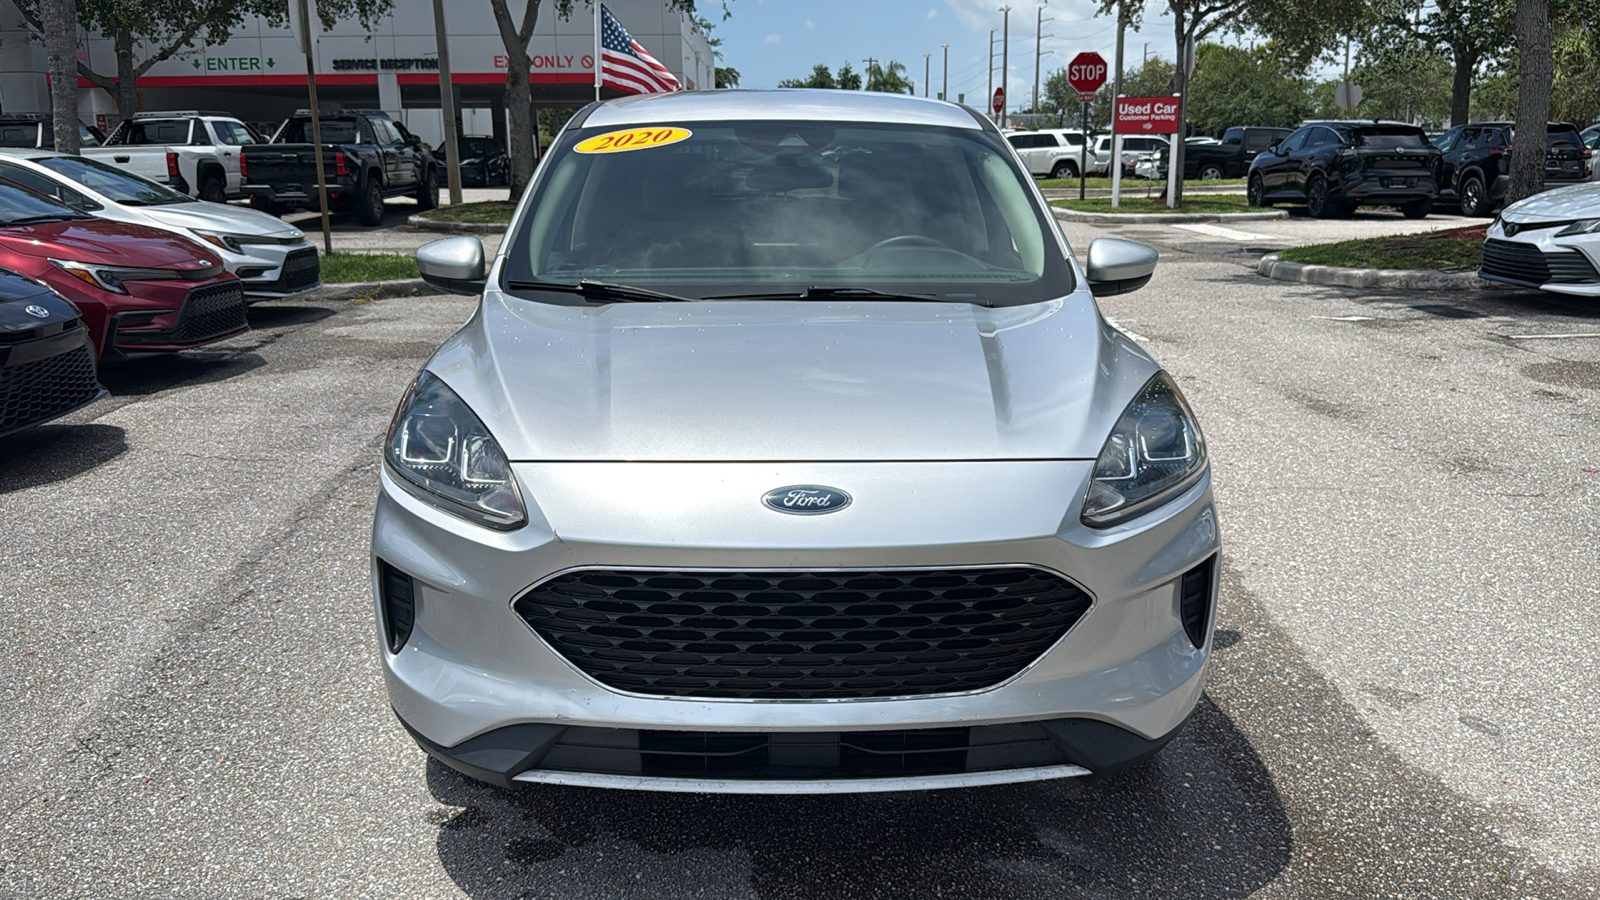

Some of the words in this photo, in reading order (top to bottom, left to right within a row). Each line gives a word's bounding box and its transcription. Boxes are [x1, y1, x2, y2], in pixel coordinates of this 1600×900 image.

[207, 57, 261, 71] ENTER
[332, 59, 378, 71] SERVICE
[380, 58, 439, 70] RECEPTION
[532, 55, 574, 69] ONLY
[1070, 64, 1105, 81] STOP
[1118, 102, 1151, 115] Used
[1153, 102, 1177, 114] Car
[592, 129, 674, 152] 2020
[783, 489, 832, 507] Ford
